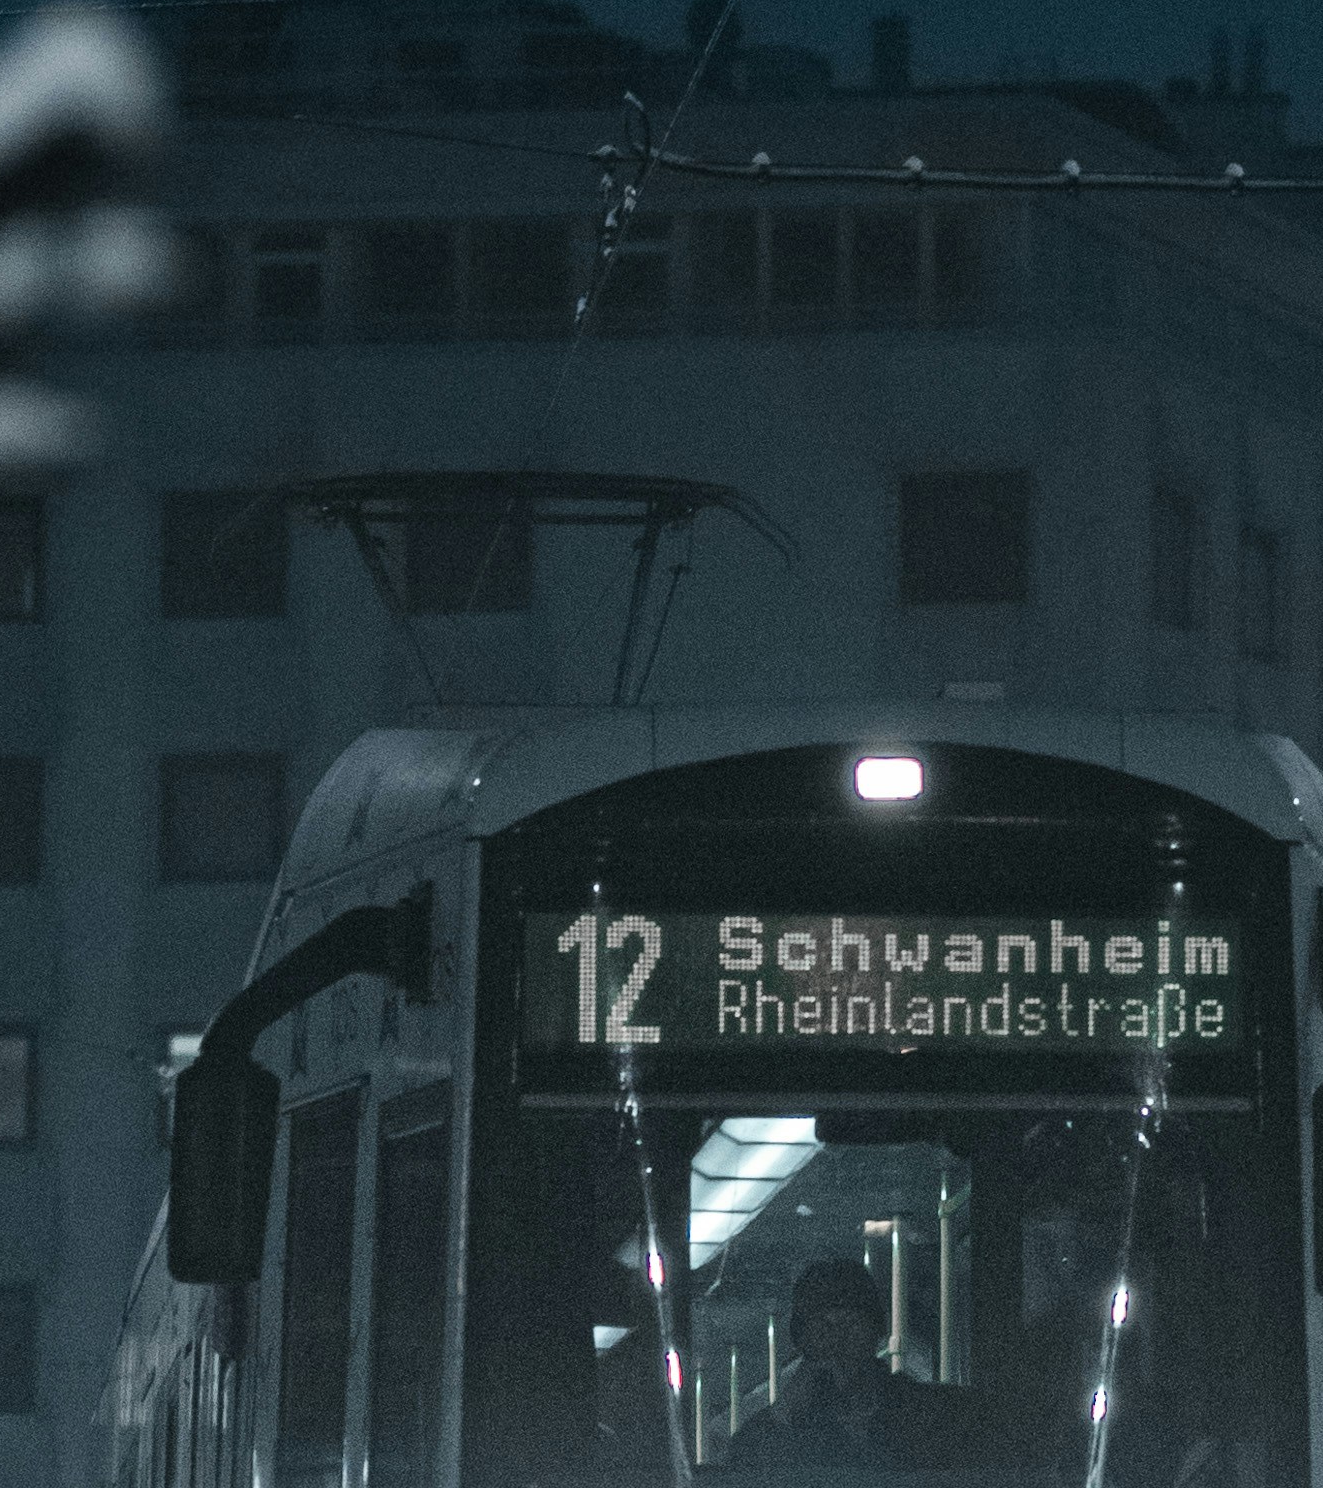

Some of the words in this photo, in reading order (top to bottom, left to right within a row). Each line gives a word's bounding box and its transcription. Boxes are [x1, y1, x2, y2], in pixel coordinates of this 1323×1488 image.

[557, 915, 662, 1044] 12
[718, 916, 1231, 975] Schwanheim
[718, 979, 1225, 1048] Rheinlandstraße
